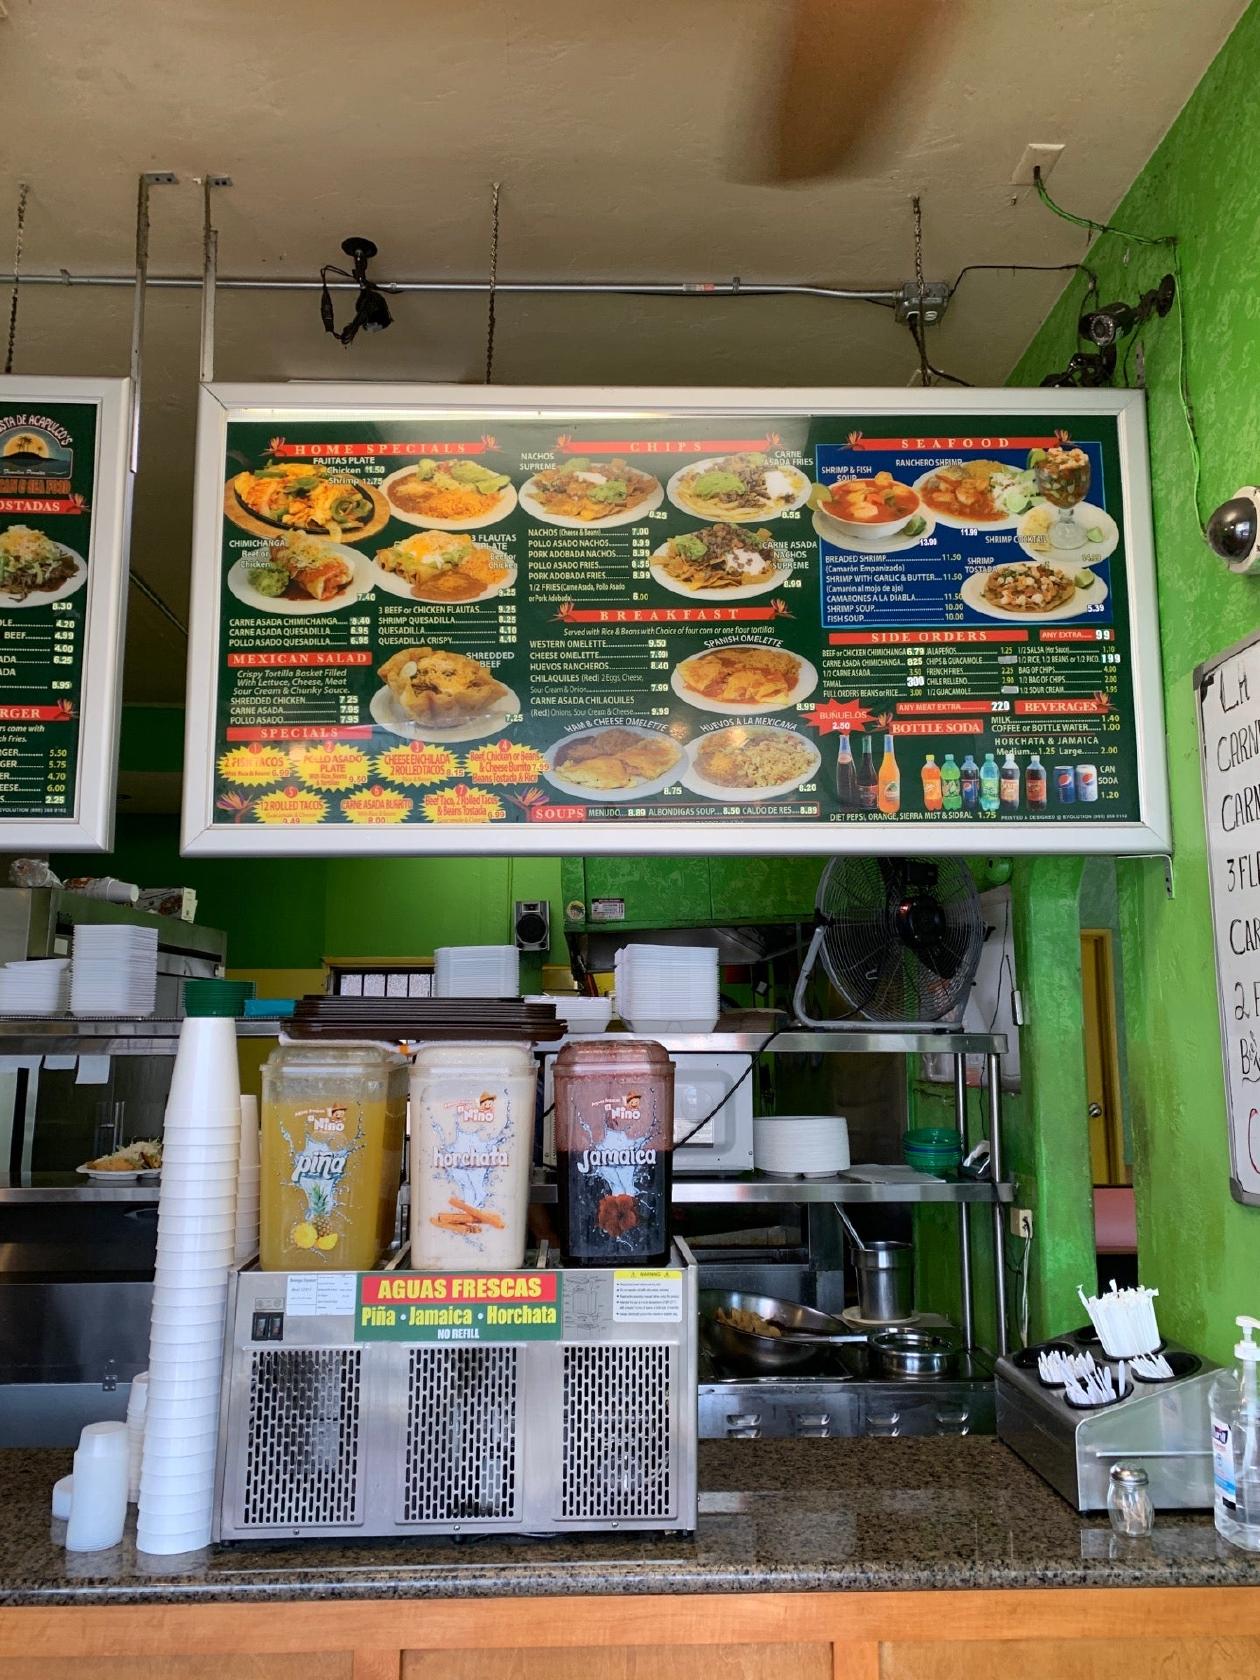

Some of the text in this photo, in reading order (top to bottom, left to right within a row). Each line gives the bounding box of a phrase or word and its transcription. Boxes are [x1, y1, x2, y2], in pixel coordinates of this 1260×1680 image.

[630, 442, 702, 452] CHIPS
[901, 438, 1009, 449] SEAFOOD
[295, 444, 466, 454] HOME SPECIALS
[520, 462, 556, 470] SUPREME
[821, 466, 848, 474] SHRIMP
[478, 534, 517, 542] FLAUTAS
[874, 574, 899, 582] GARLIC
[384, 606, 402, 614] BEEF
[600, 609, 738, 620] BREAKFAST
[229, 618, 255, 626] CARNE
[256, 618, 281, 626] ASADA
[378, 637, 425, 645] QUESADILLA
[704, 635, 784, 648] SPANISH OMELETTE
[872, 632, 987, 642] SIDE ORDERS
[529, 640, 606, 648] WESTERN OMELETTE
[233, 653, 367, 664] MEXICAN SALAD
[563, 662, 609, 670] RANCHEROS
[530, 674, 579, 683] CHILAQUILES
[274, 696, 305, 704] CHICKEN
[1024, 701, 1097, 711] BEVERAGES
[257, 716, 283, 724] ASADO
[594, 718, 624, 726] CHEESE
[626, 718, 669, 731] OMELETTE
[700, 718, 734, 732] HUEVOS
[755, 718, 797, 731] MEXICANA
[260, 728, 338, 738] SPECIALS
[892, 723, 980, 733] BOTTLE SODA
[1032, 724, 1060, 732] BOTTLE
[994, 737, 1043, 745] HORCHATA
[1057, 737, 1098, 745] JAMAICA
[45, 796, 64, 804] 2.25
[536, 808, 584, 819] SOUPS
[432, 1144, 508, 1168] horchata
[378, 1278, 542, 1298] AGUAS FRESCAS
[361, 1306, 557, 1326] Piña Jamaica Horchata
[438, 1328, 479, 1339] NO REFILL
